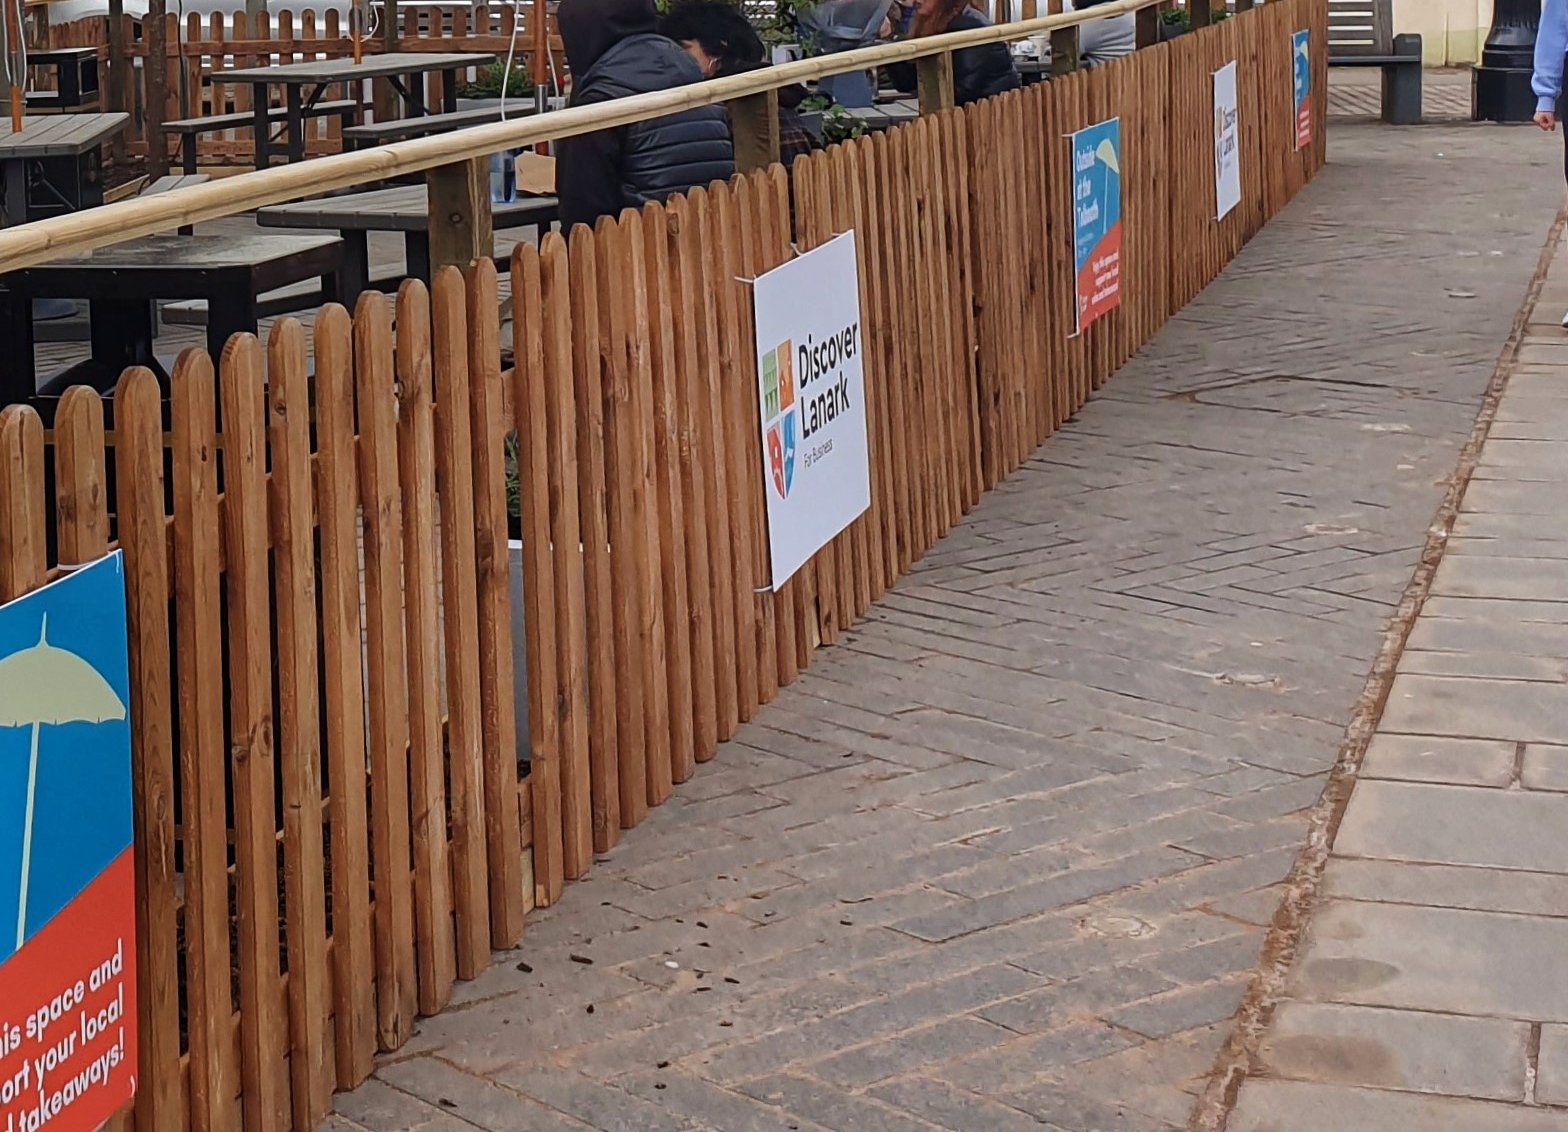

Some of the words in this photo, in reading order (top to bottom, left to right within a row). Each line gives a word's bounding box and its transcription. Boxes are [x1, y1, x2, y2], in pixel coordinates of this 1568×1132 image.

[797, 321, 858, 390] Discover
[800, 370, 850, 440] Lanark
[812, 437, 834, 463] Business
[26, 980, 85, 1043] space
[88, 937, 123, 992] and
[19, 1026, 125, 1132] takeaways!
[34, 1029, 77, 1092] your
[81, 981, 123, 1046] local
